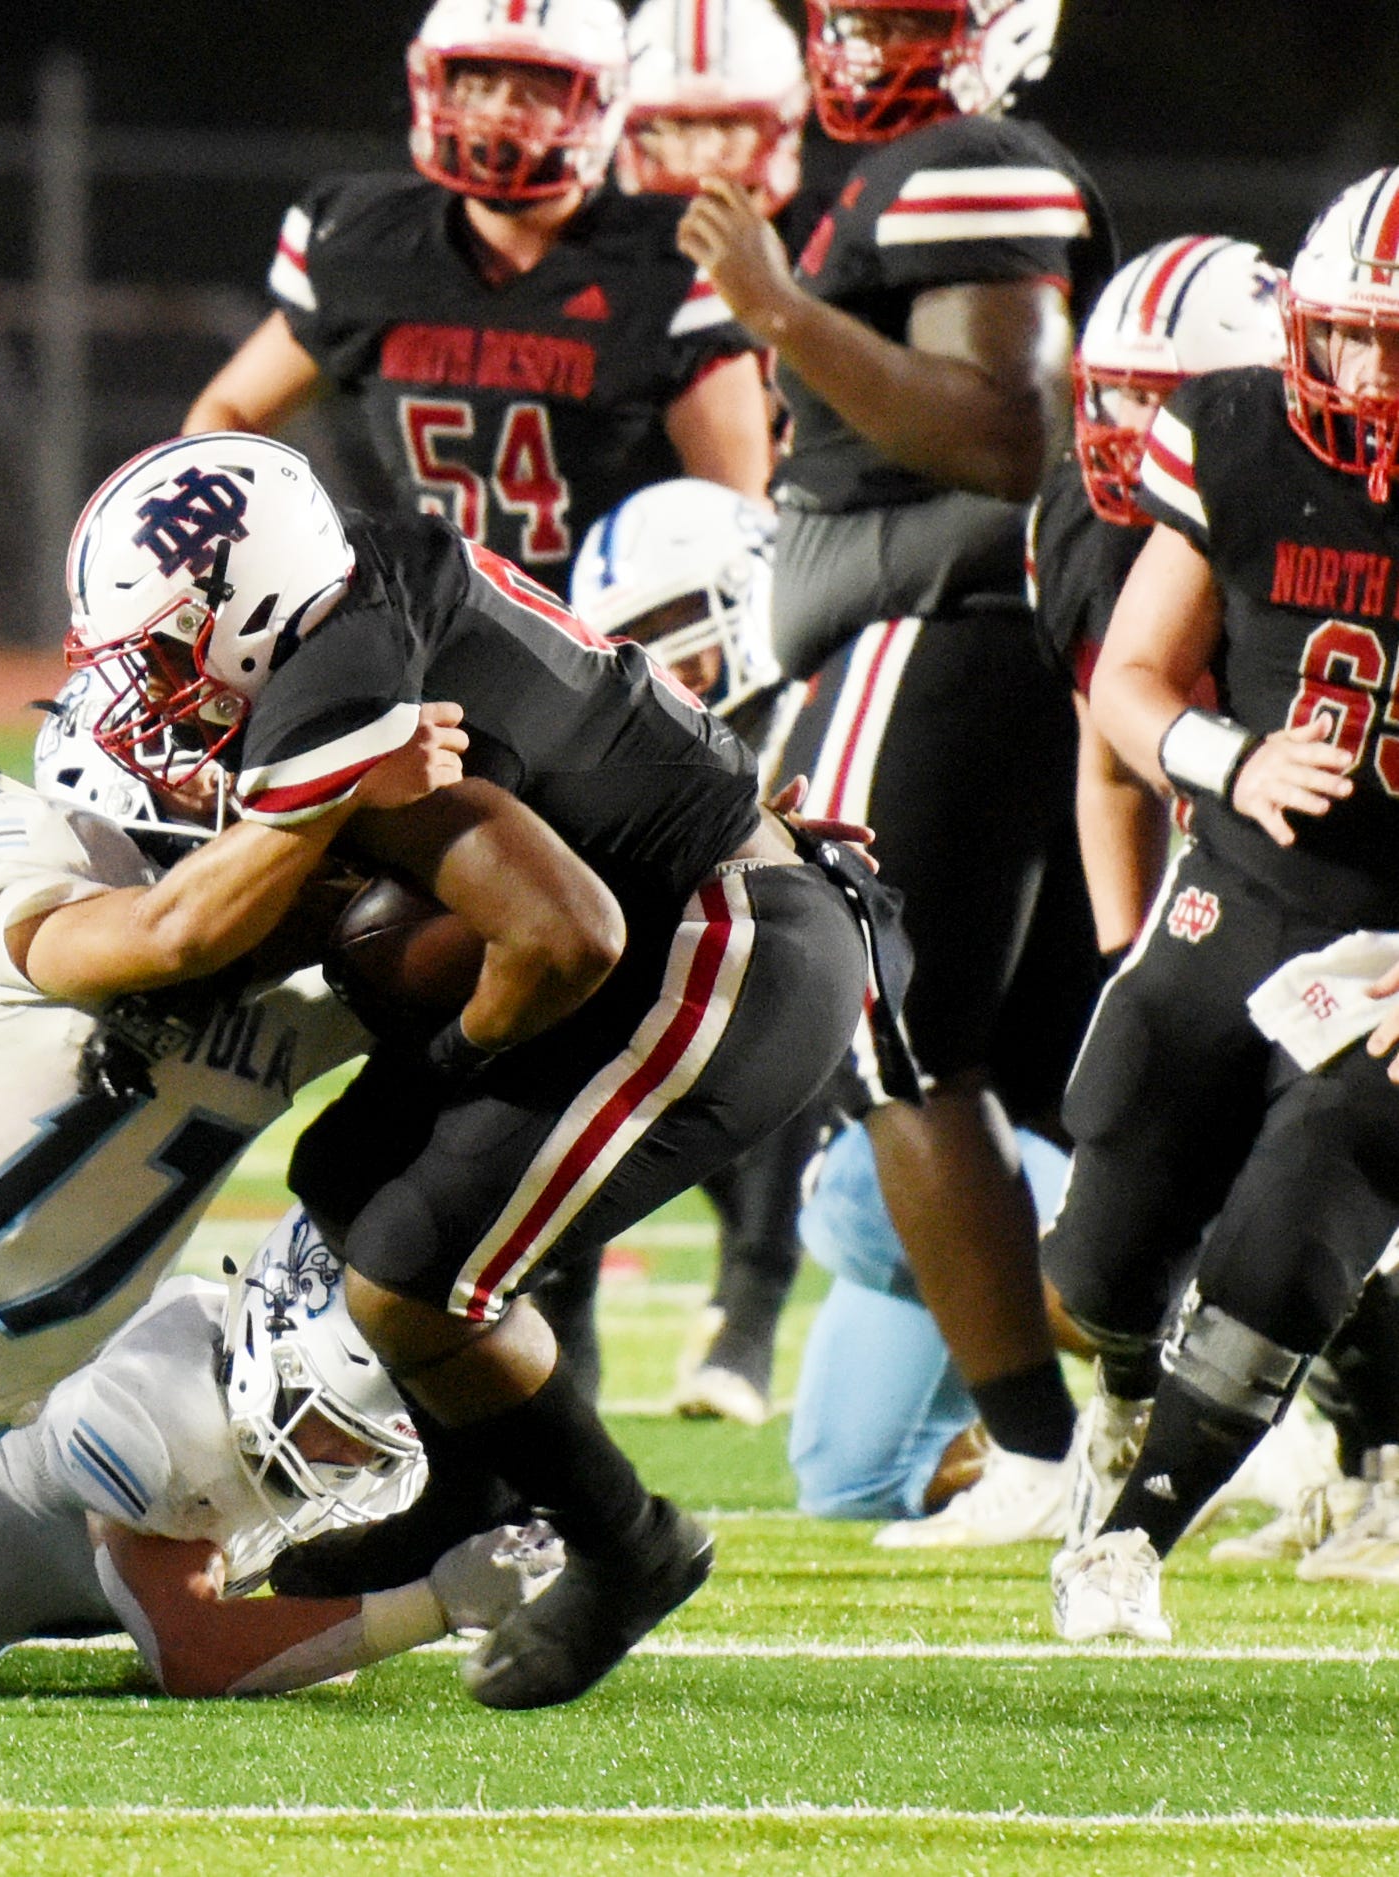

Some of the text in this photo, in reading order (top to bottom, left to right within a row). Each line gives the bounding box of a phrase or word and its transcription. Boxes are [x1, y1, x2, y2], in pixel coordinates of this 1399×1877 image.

[397, 395, 570, 563] 54
[1270, 541, 1392, 618] NORTH
[1302, 982, 1340, 1021] 65
